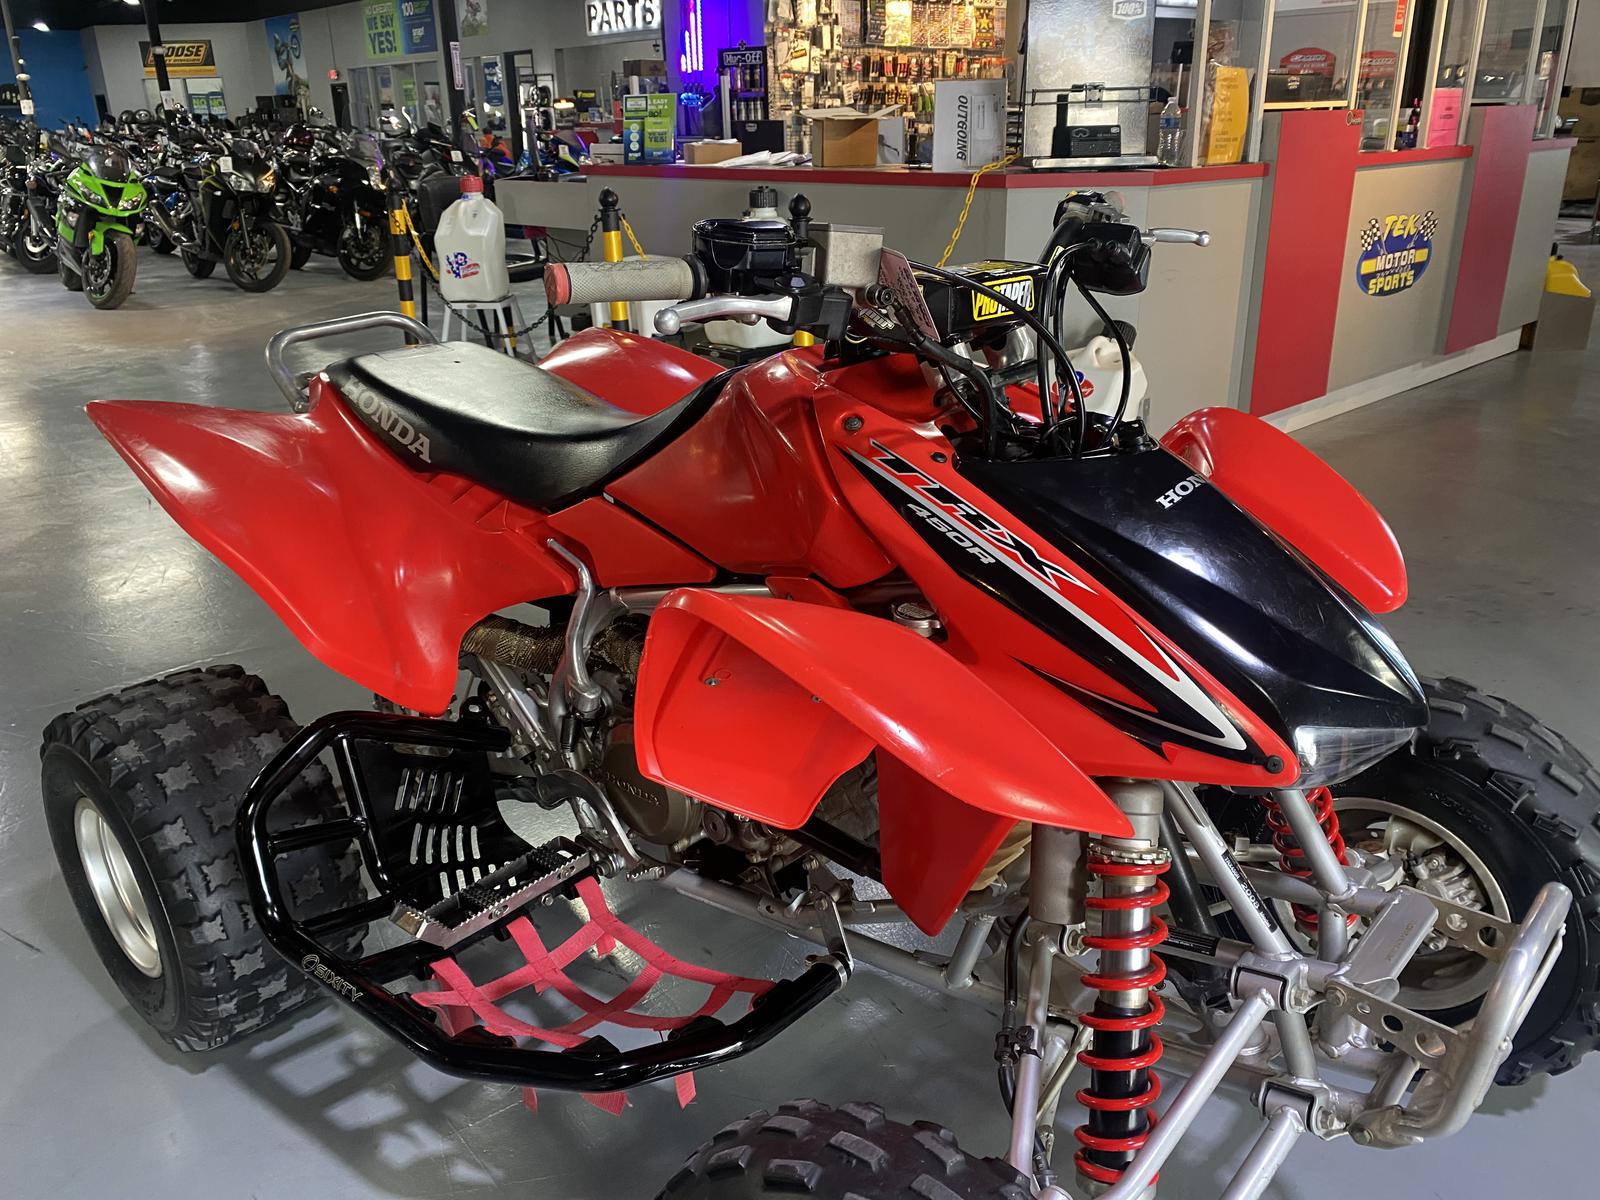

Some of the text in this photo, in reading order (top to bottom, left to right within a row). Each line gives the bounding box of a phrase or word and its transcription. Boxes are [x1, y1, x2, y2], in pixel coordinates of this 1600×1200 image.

[587, 0, 655, 32] PARTS
[1117, 2, 1144, 15] 100%
[158, 45, 204, 58] OOSE
[368, 30, 397, 55] YES!
[956, 95, 969, 161] OUTGOING
[1384, 214, 1420, 241] TEK
[1375, 249, 1415, 272] MOTOR
[1368, 270, 1415, 295] SPORTS
[341, 374, 431, 464] HONDA
[905, 503, 996, 565] 450R
[1241, 881, 1260, 910] 2008
